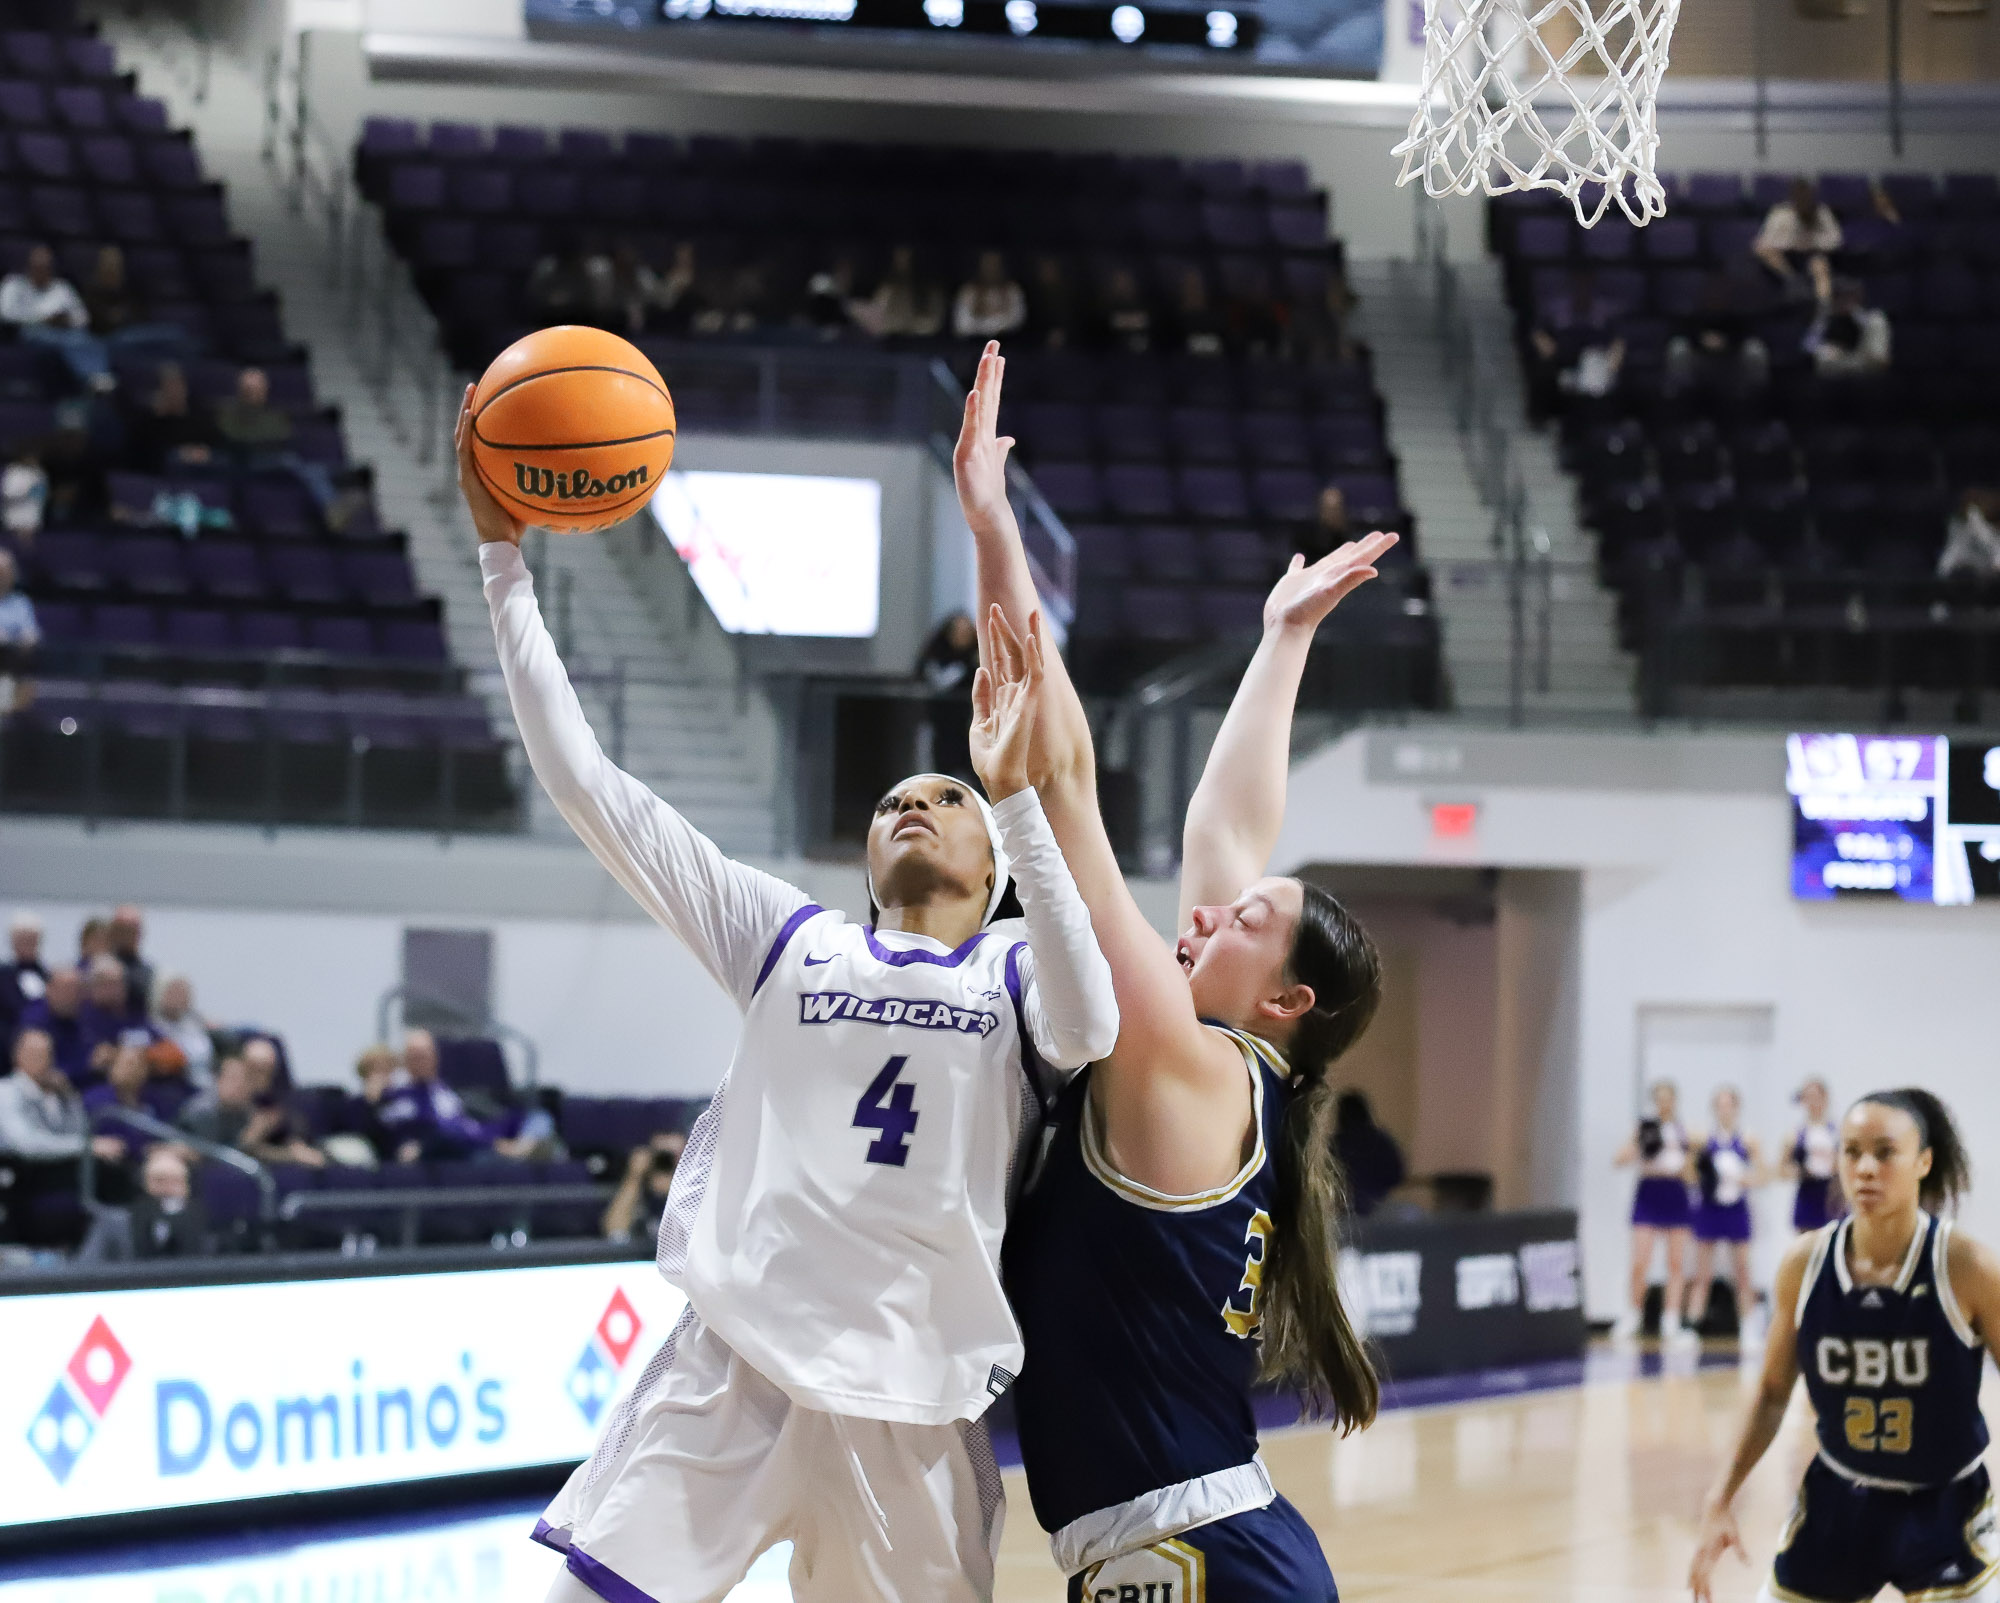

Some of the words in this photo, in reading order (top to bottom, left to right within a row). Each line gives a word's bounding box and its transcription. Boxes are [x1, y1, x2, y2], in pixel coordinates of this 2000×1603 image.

[513, 461, 648, 499] Wilson
[800, 992, 998, 1038] WILDCATS
[851, 1054, 919, 1168] 4
[1817, 1337, 1929, 1386] CBU
[156, 1352, 505, 1477] Domino's
[1845, 1398, 1913, 1454] 23
